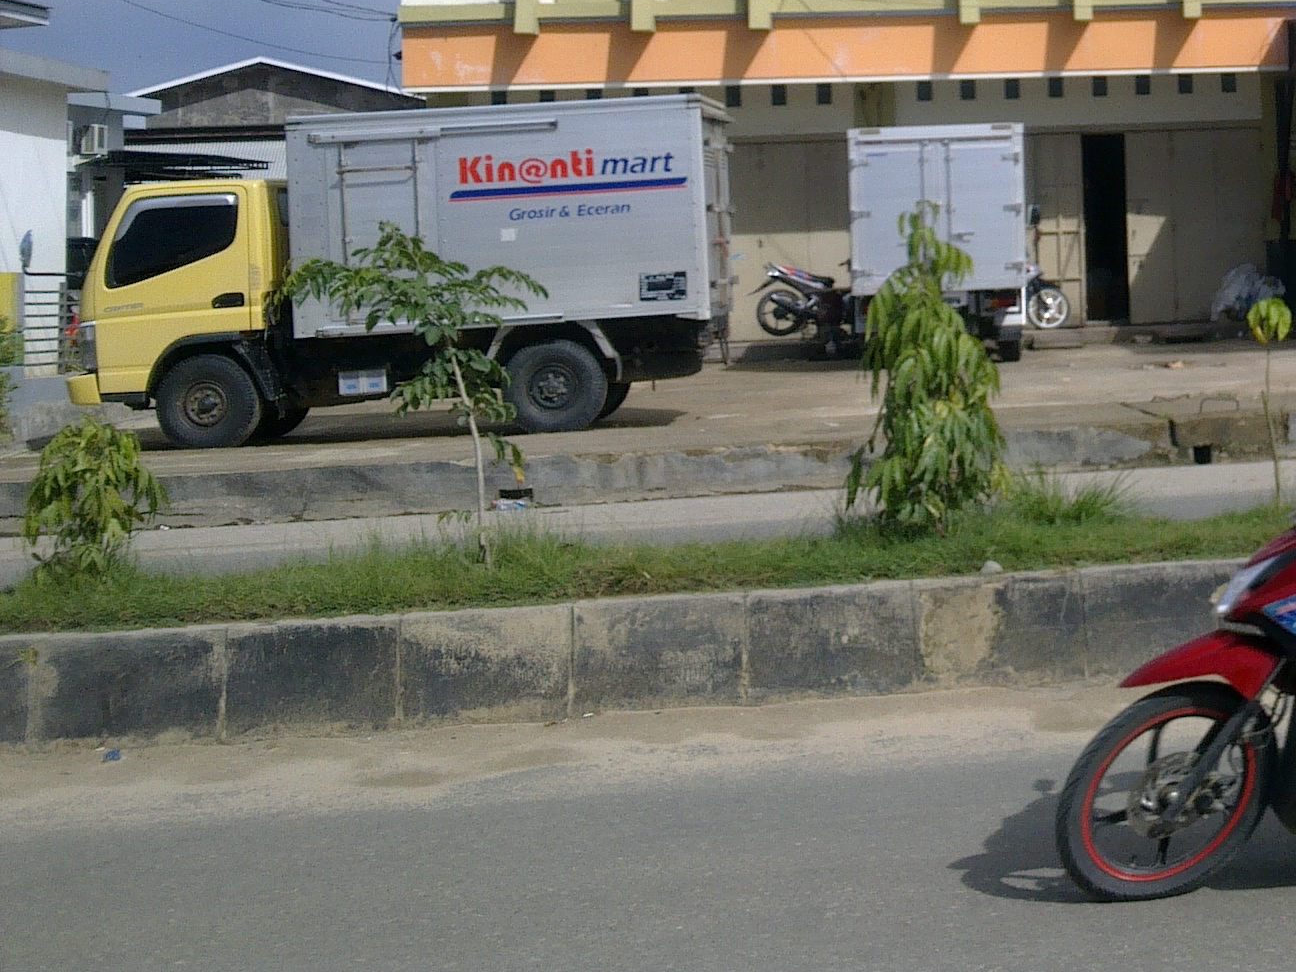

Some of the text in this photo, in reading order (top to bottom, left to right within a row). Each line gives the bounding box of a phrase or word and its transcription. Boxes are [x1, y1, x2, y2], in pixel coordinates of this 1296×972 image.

[601, 152, 674, 175] mart
[509, 202, 631, 221] Grosir & Eceran
